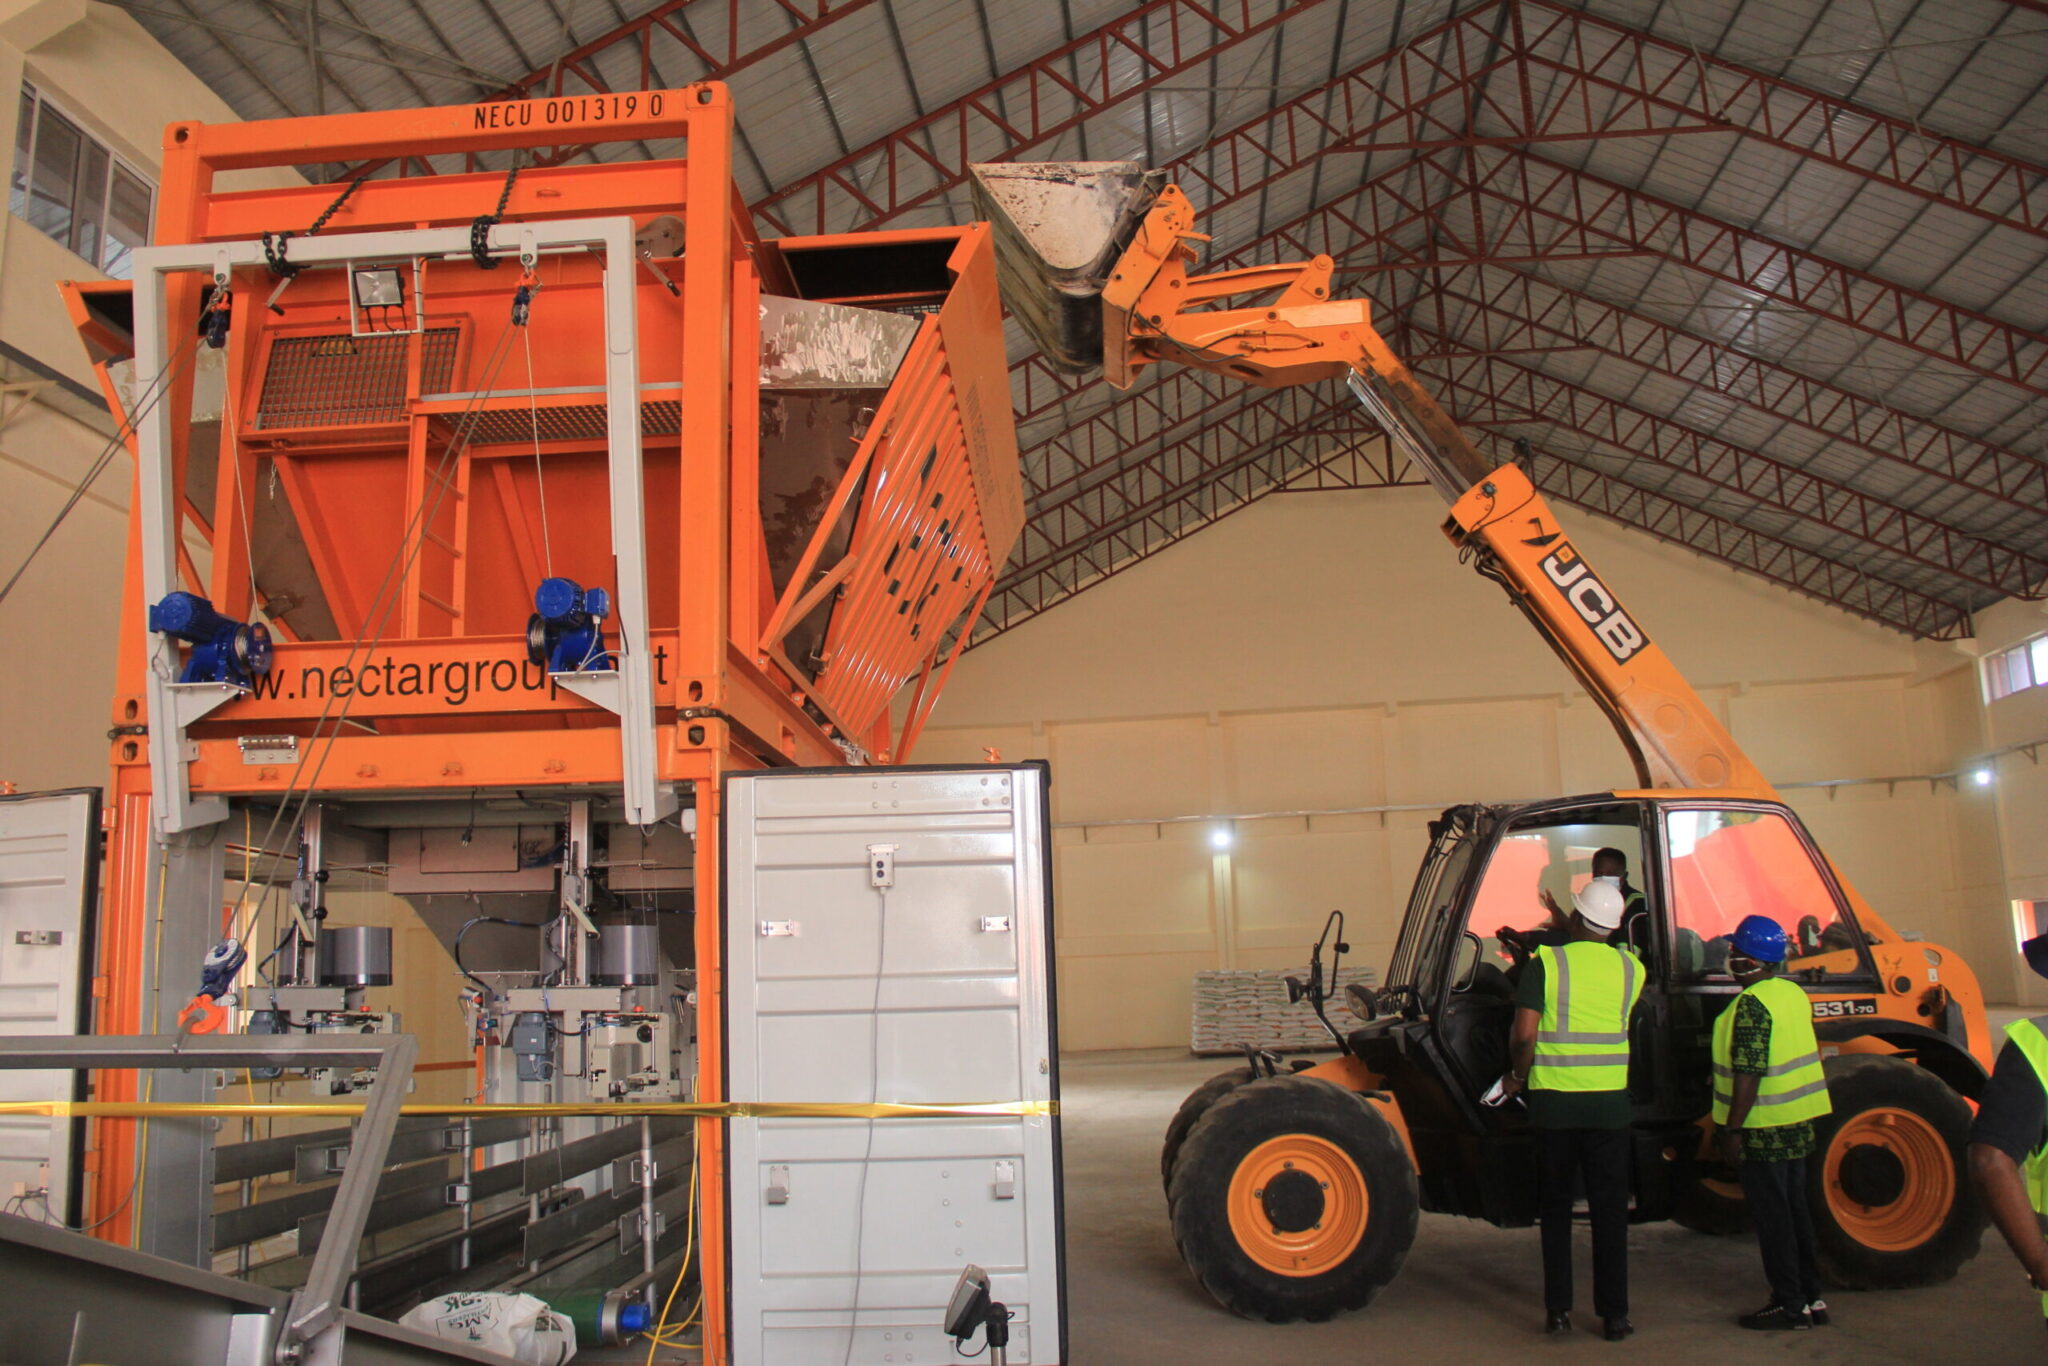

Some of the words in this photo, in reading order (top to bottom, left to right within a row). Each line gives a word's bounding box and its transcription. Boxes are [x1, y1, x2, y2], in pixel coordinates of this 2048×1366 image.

[474, 103, 532, 130] NECU
[546, 95, 638, 124] 001319
[1543, 555, 1643, 660] JCB
